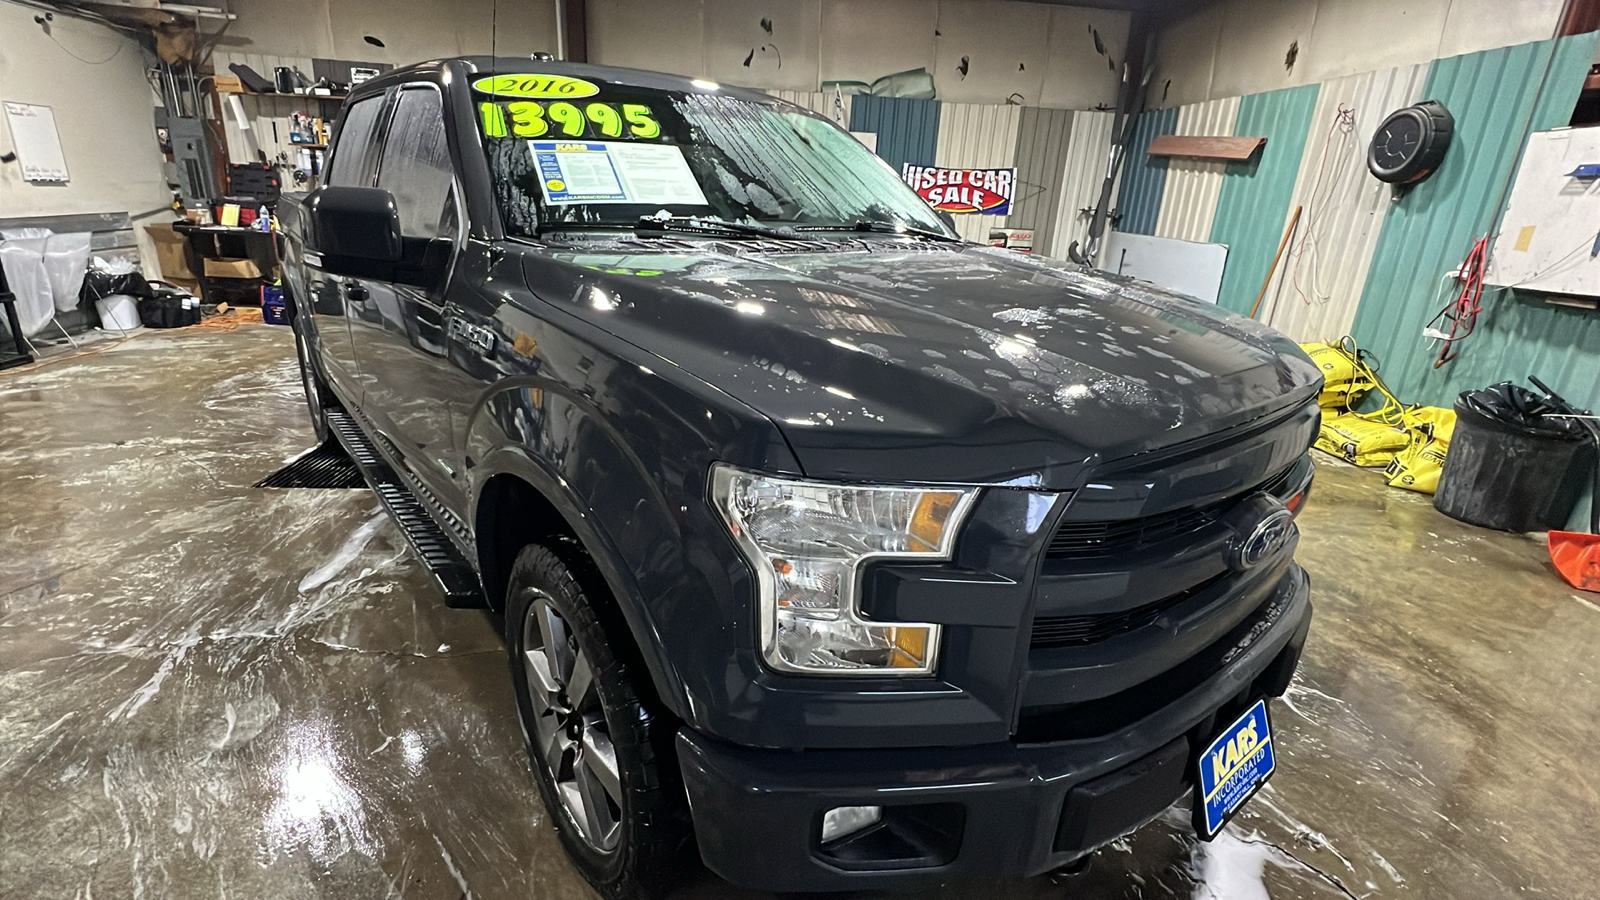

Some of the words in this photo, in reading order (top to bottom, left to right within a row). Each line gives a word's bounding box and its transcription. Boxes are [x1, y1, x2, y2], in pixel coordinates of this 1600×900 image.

[498, 79, 576, 94] 2016
[480, 102, 660, 138] 13995
[555, 143, 588, 151] KARS
[907, 166, 963, 192] USED
[968, 169, 1012, 200] CAR
[928, 187, 985, 211] SALE
[1212, 718, 1258, 786] KARS
[1213, 748, 1265, 808] INCORPORATED
